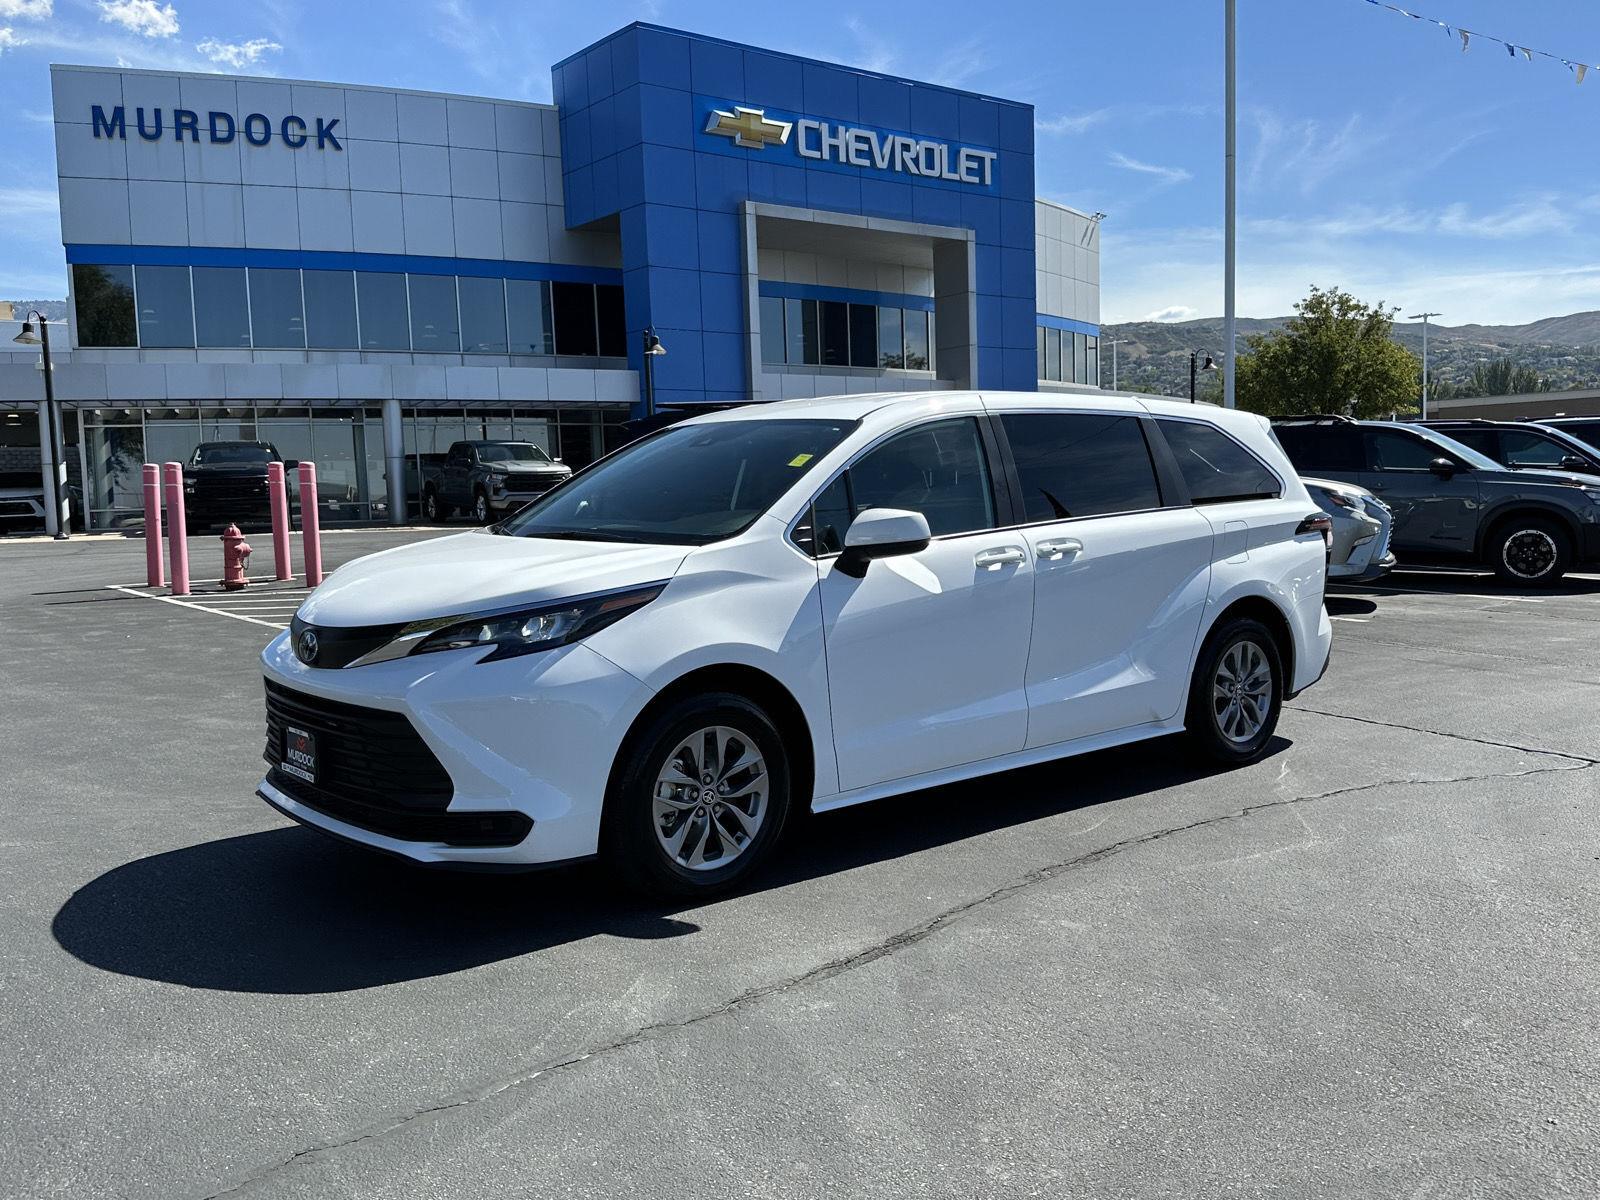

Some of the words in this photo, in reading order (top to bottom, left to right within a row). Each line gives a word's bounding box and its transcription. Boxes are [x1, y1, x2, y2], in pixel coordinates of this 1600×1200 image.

[91, 105, 343, 151] MURDOCK
[797, 118, 998, 185] CHEVROLET
[287, 747, 315, 769] MURDOCK
